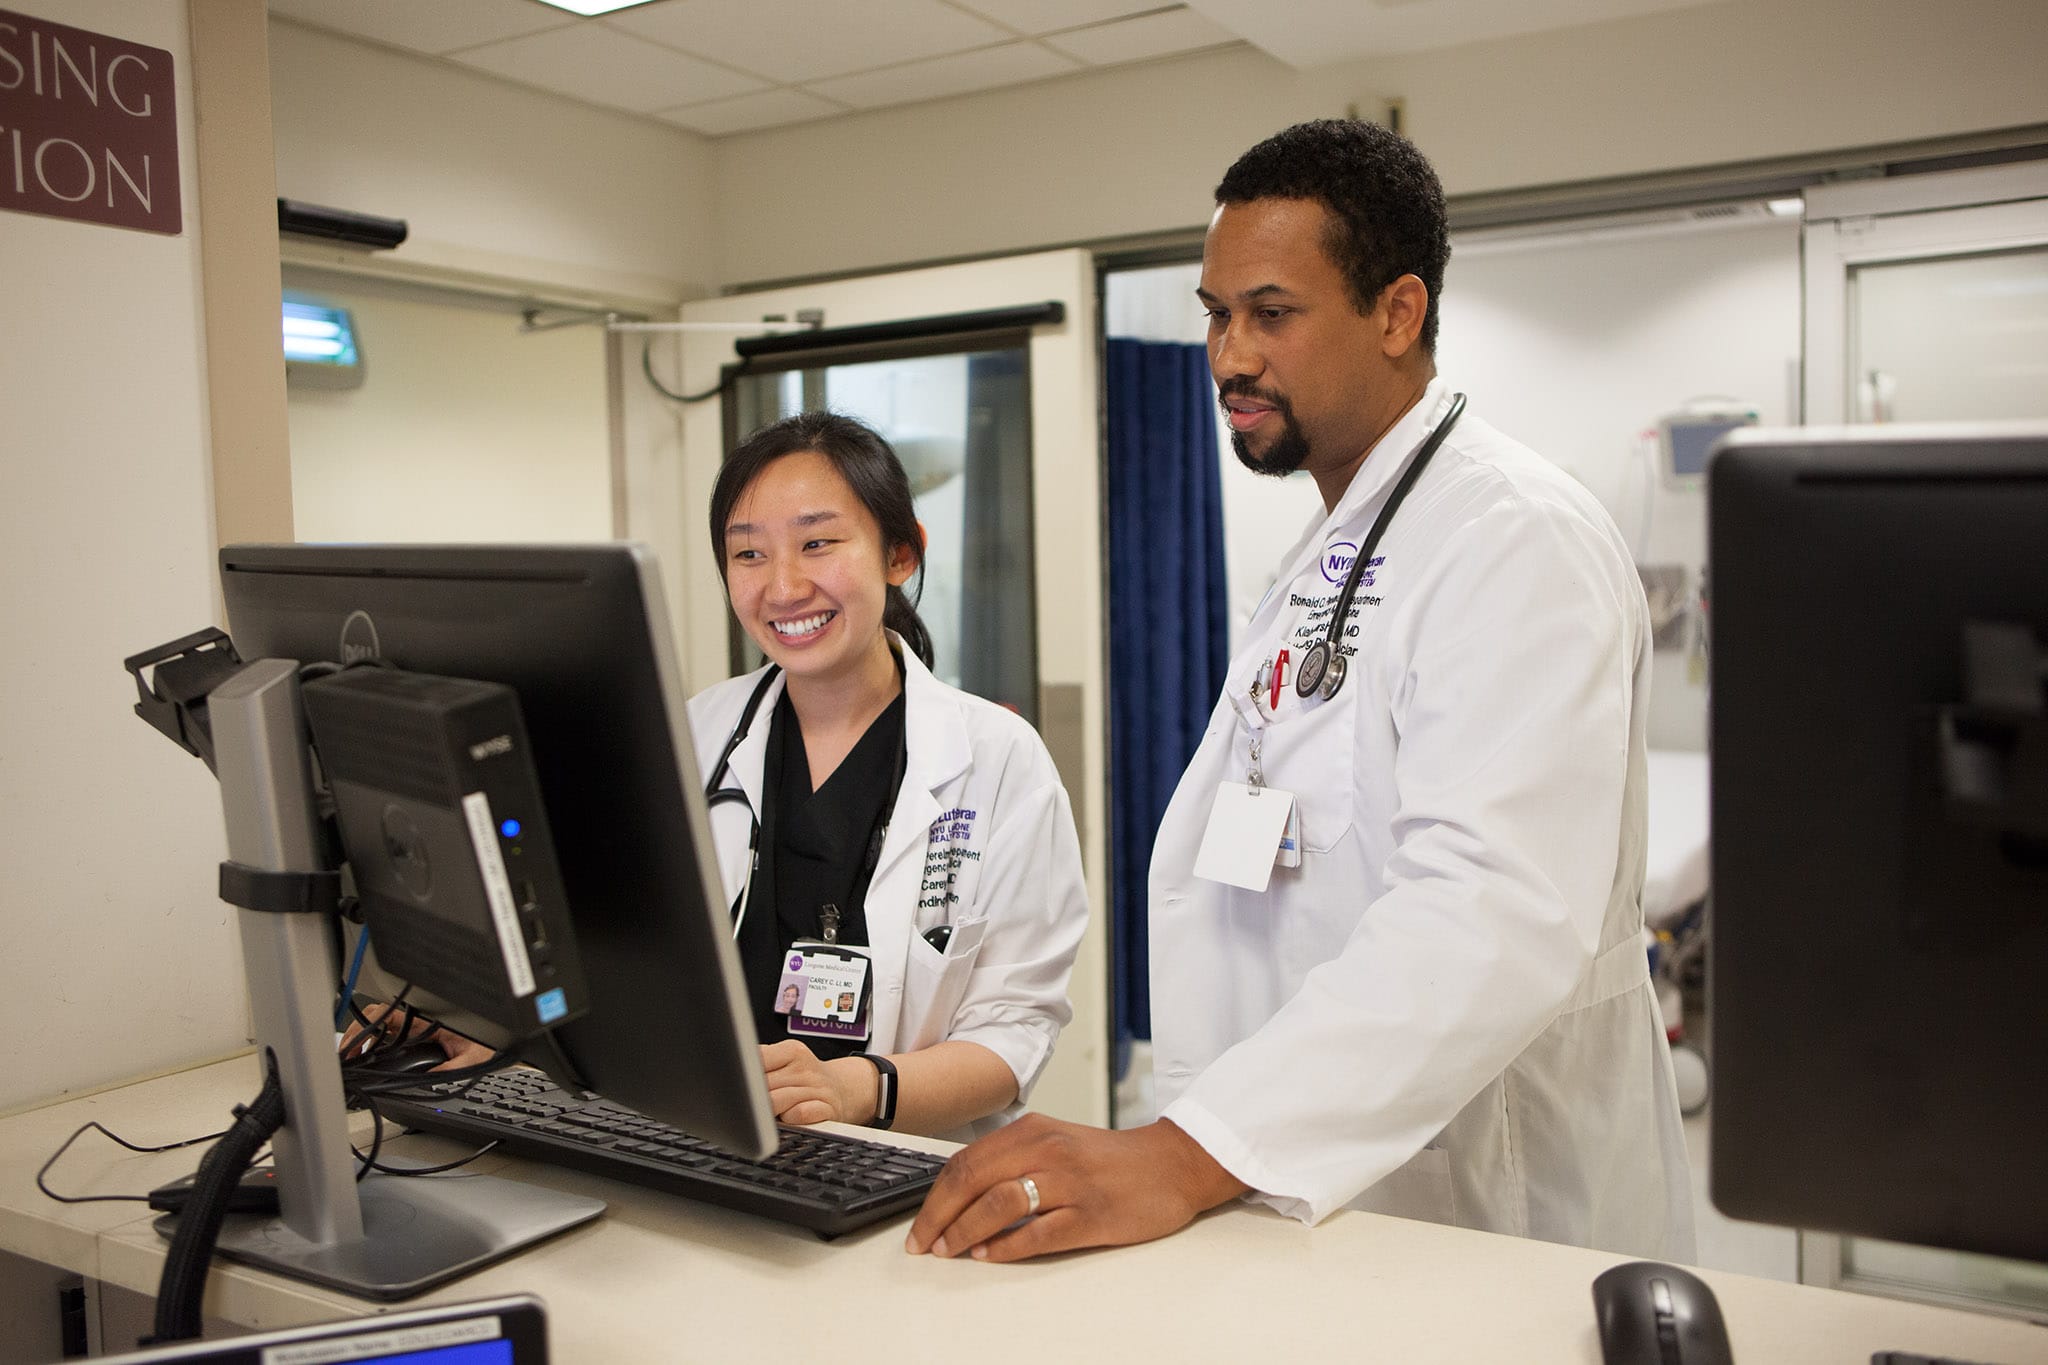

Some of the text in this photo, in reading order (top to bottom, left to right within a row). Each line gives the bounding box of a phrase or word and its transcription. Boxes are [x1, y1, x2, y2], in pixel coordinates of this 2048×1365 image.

[0, 127, 152, 214] ION
[1290, 594, 1320, 608] Ronald
[1344, 624, 1360, 638] MD
